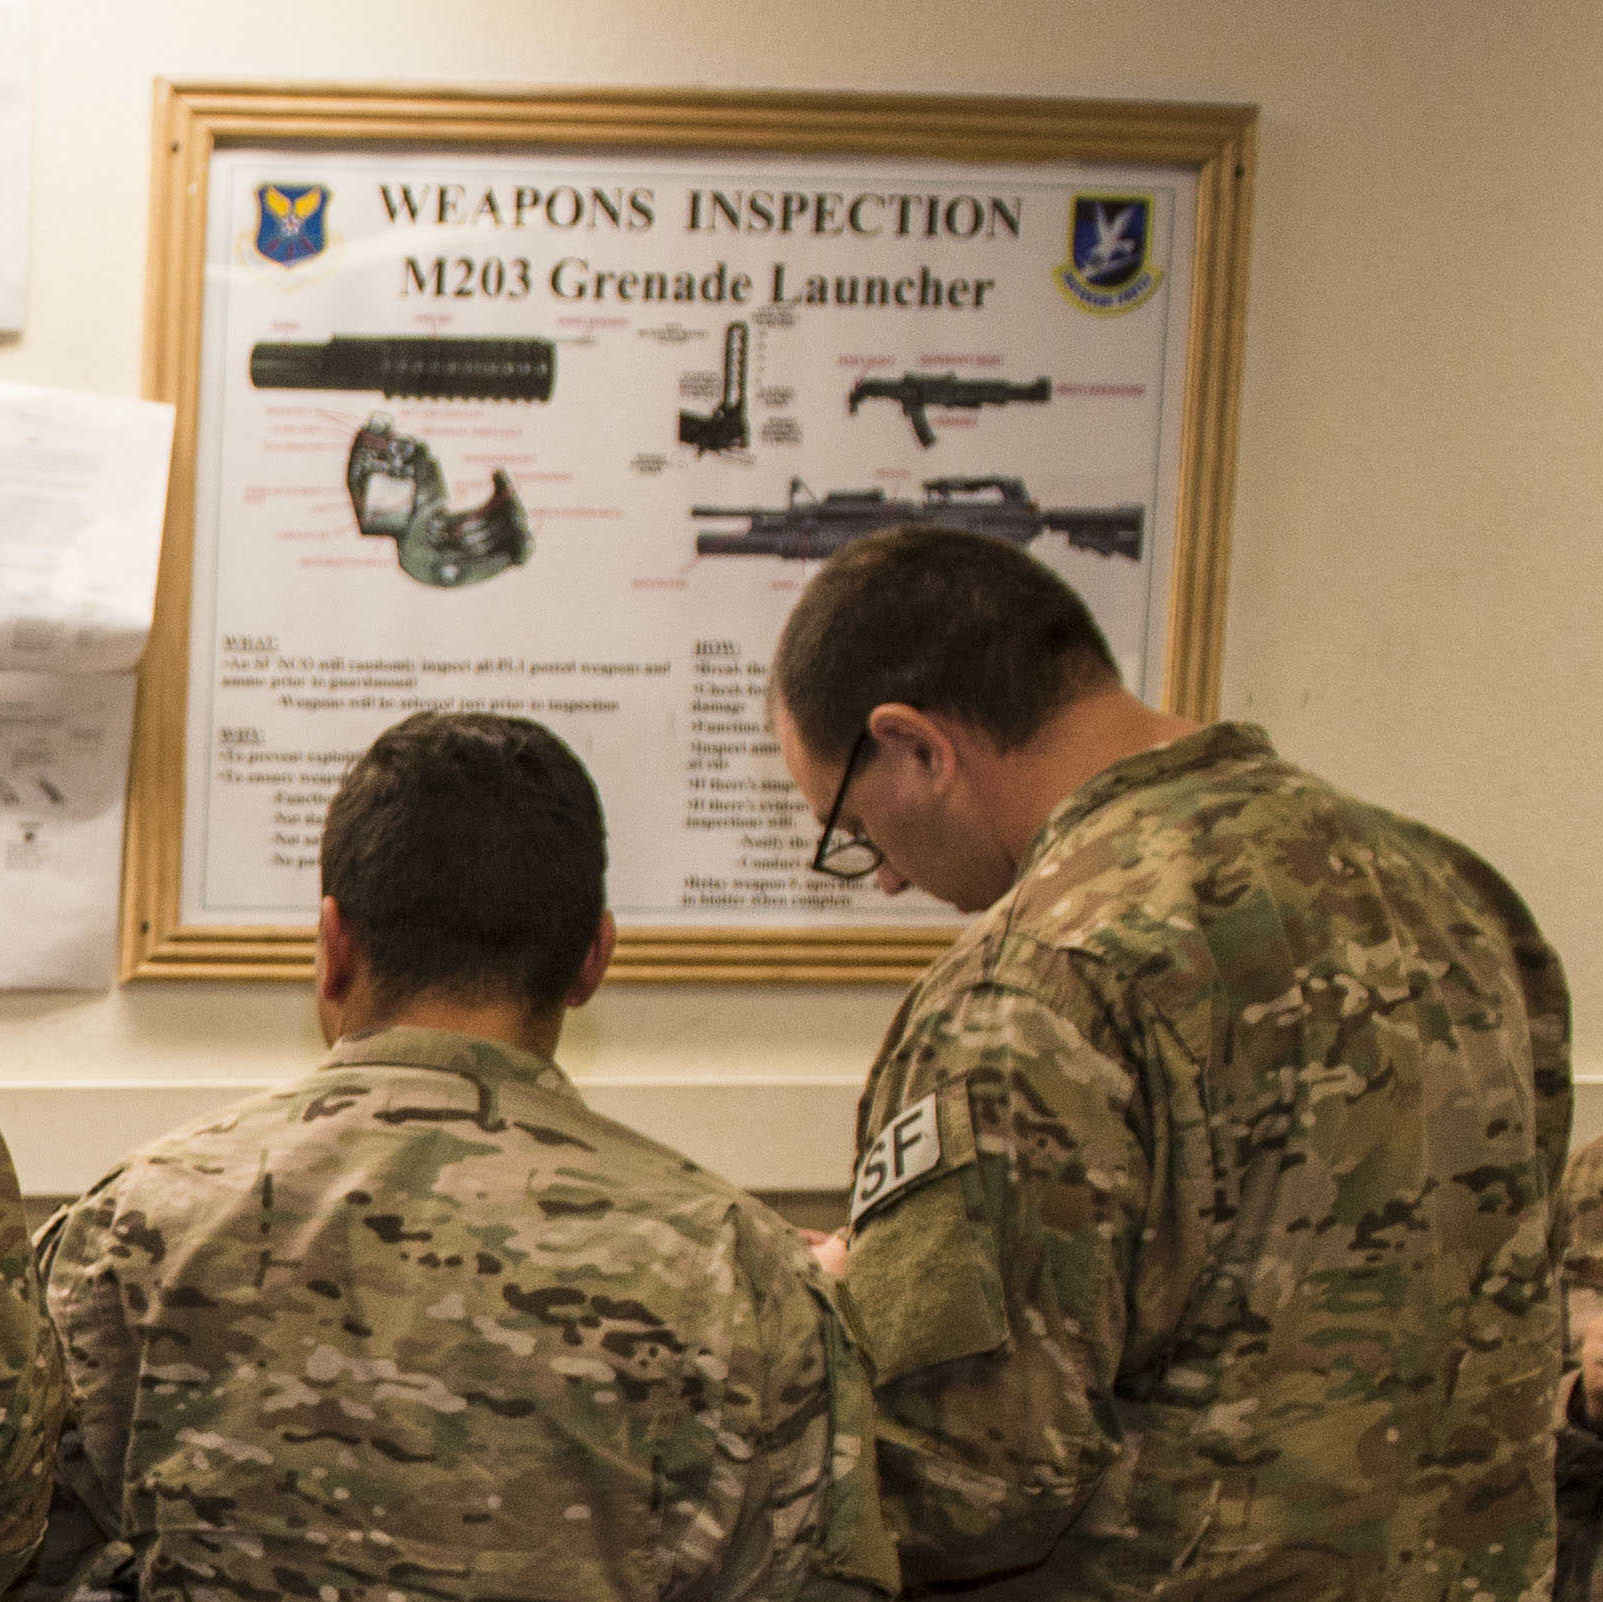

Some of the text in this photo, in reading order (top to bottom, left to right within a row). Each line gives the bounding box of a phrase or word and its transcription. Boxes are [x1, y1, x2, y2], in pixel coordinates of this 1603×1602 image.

[378, 183, 1023, 239] WEAPONS INSPECTION
[399, 255, 995, 309] M203 Grenade Launcher
[861, 1108, 924, 1202] SF
